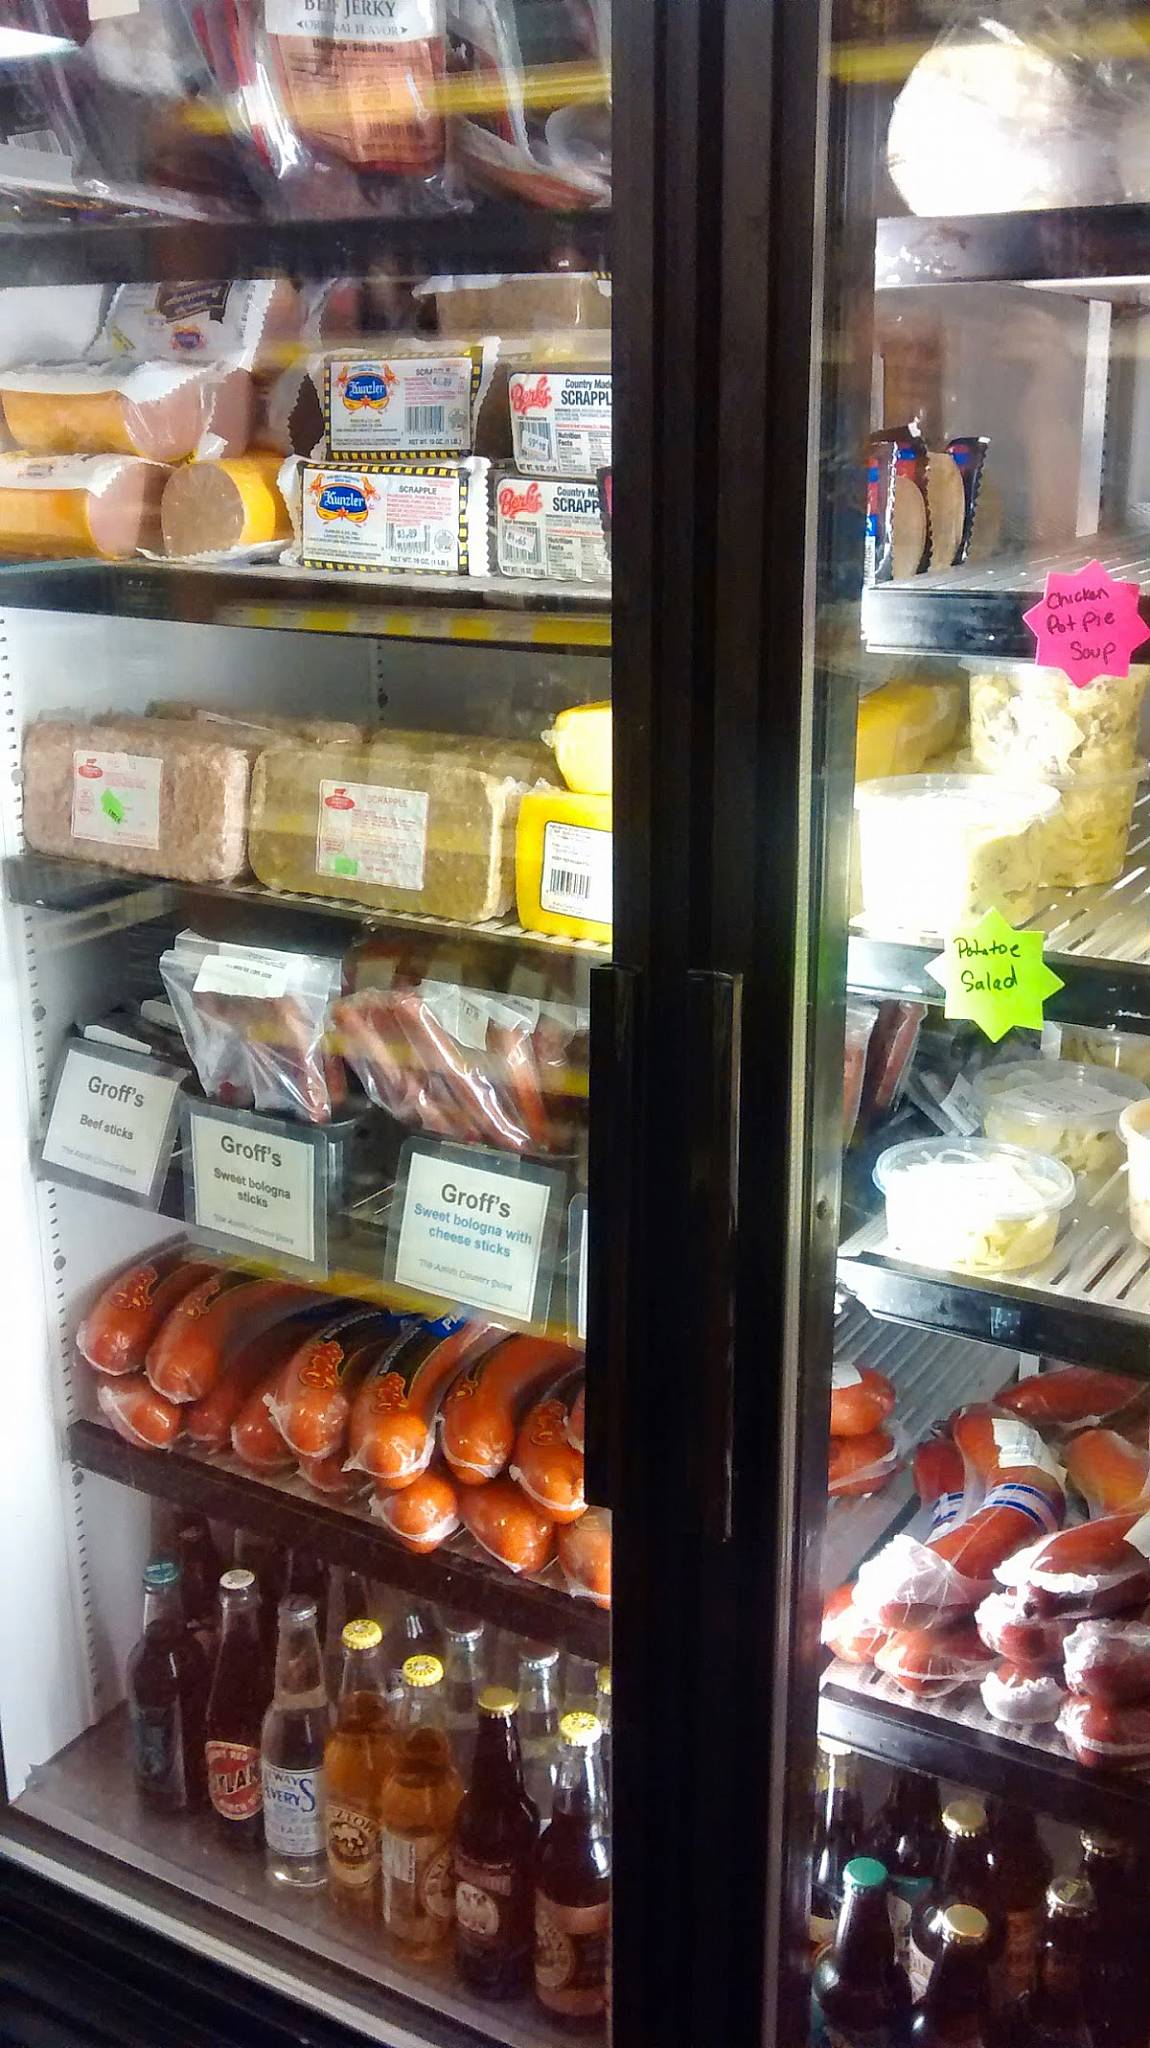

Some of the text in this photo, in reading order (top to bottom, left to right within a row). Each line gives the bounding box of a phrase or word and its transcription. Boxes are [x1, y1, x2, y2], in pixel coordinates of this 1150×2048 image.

[344, 0, 396, 18] JERKY
[348, 381, 385, 396] Kunzler
[565, 379, 612, 391] Country Mad
[561, 390, 612, 406] SCRAPPL
[323, 490, 365, 507] Kunzler
[399, 485, 437, 495] SCRAPPLE
[557, 486, 585, 498] Country
[553, 497, 602, 513] SCRAPP
[1046, 588, 1109, 609] Chicken
[1047, 611, 1115, 635] Pot Pie
[1070, 641, 1116, 665] Soup
[961, 964, 1018, 993] Salad
[88, 1076, 145, 1108] Groff's
[80, 1114, 134, 1140] Beef sticks
[221, 1135, 282, 1167] Groff's
[214, 1168, 291, 1200] Sweet bologna
[238, 1191, 268, 1208] sticks
[441, 1183, 511, 1218] Groff's
[414, 1203, 532, 1245] Sweet bologna with
[429, 1227, 511, 1258] cheese sticks
